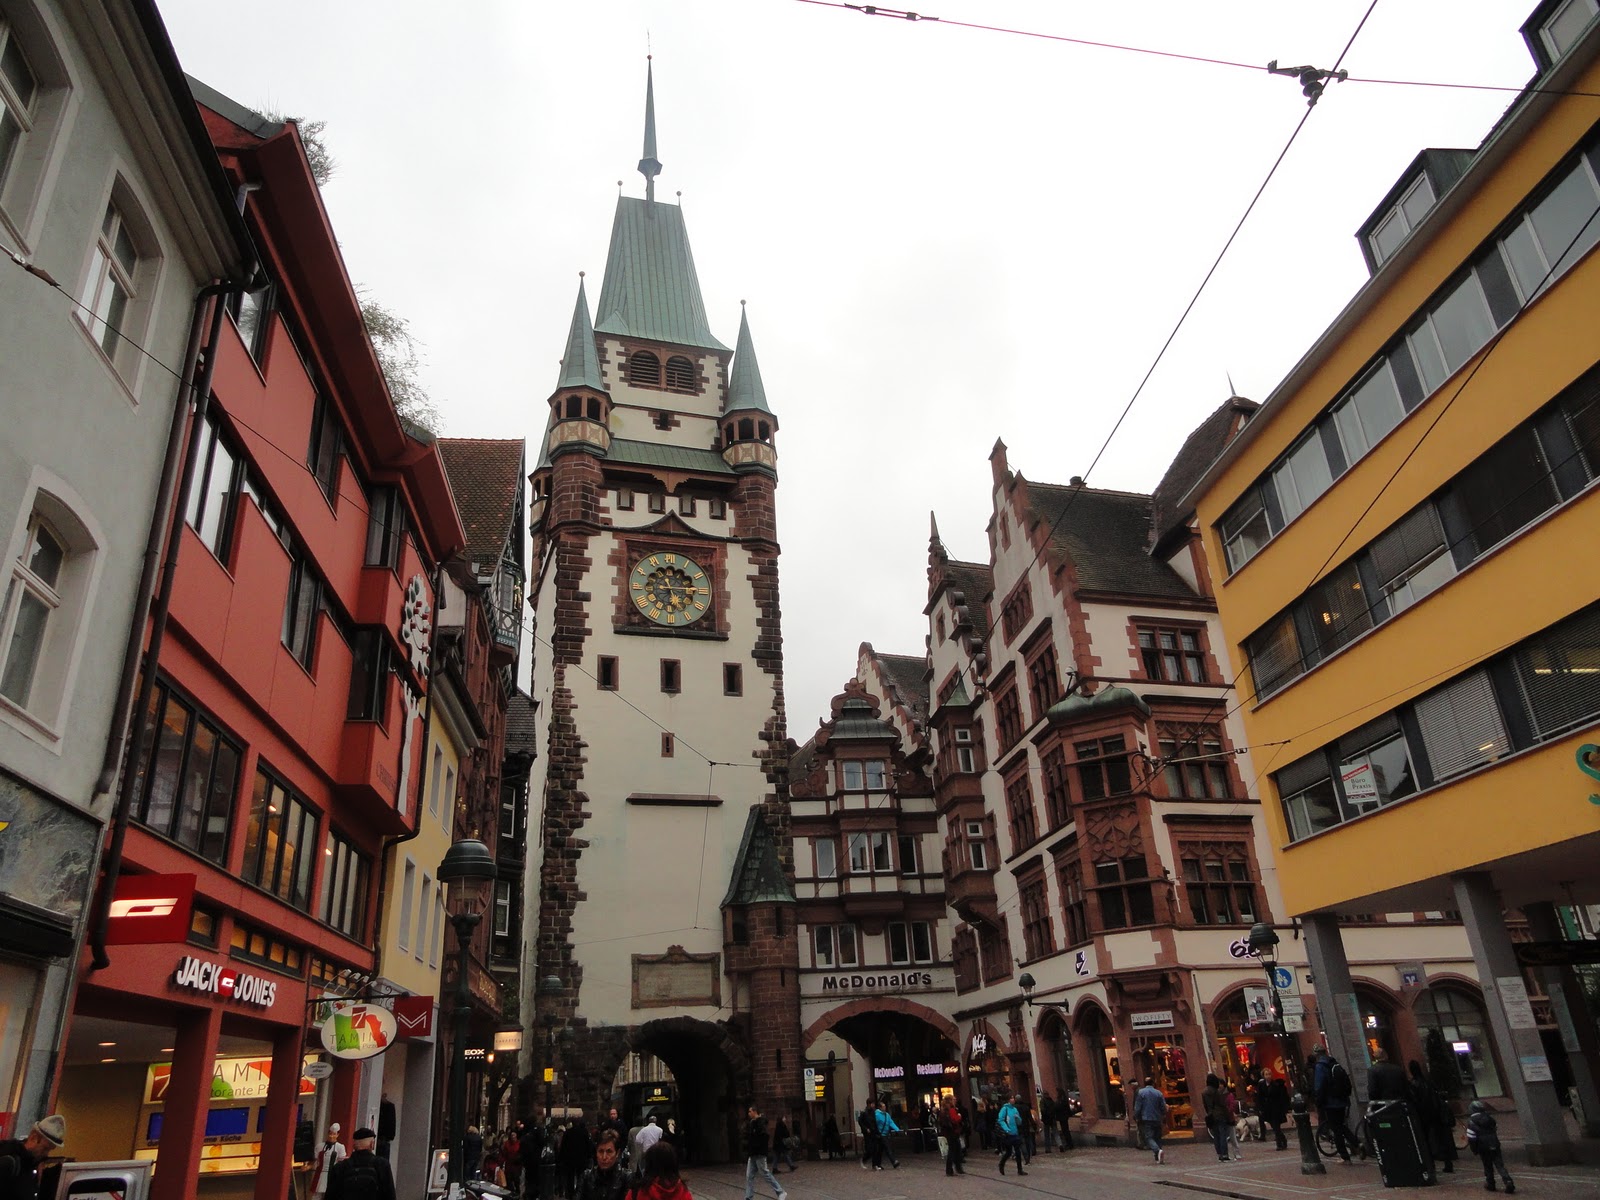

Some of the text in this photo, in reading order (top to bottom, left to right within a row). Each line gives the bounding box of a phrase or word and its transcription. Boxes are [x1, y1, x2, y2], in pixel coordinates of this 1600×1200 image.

[176, 955, 277, 1007] JACK JONES
[822, 972, 932, 990] McDonald's
[464, 1048, 485, 1056] EOX
[874, 1065, 905, 1078] McDonald's
[916, 1063, 943, 1075] Restaura
[211, 1086, 253, 1097] torante
